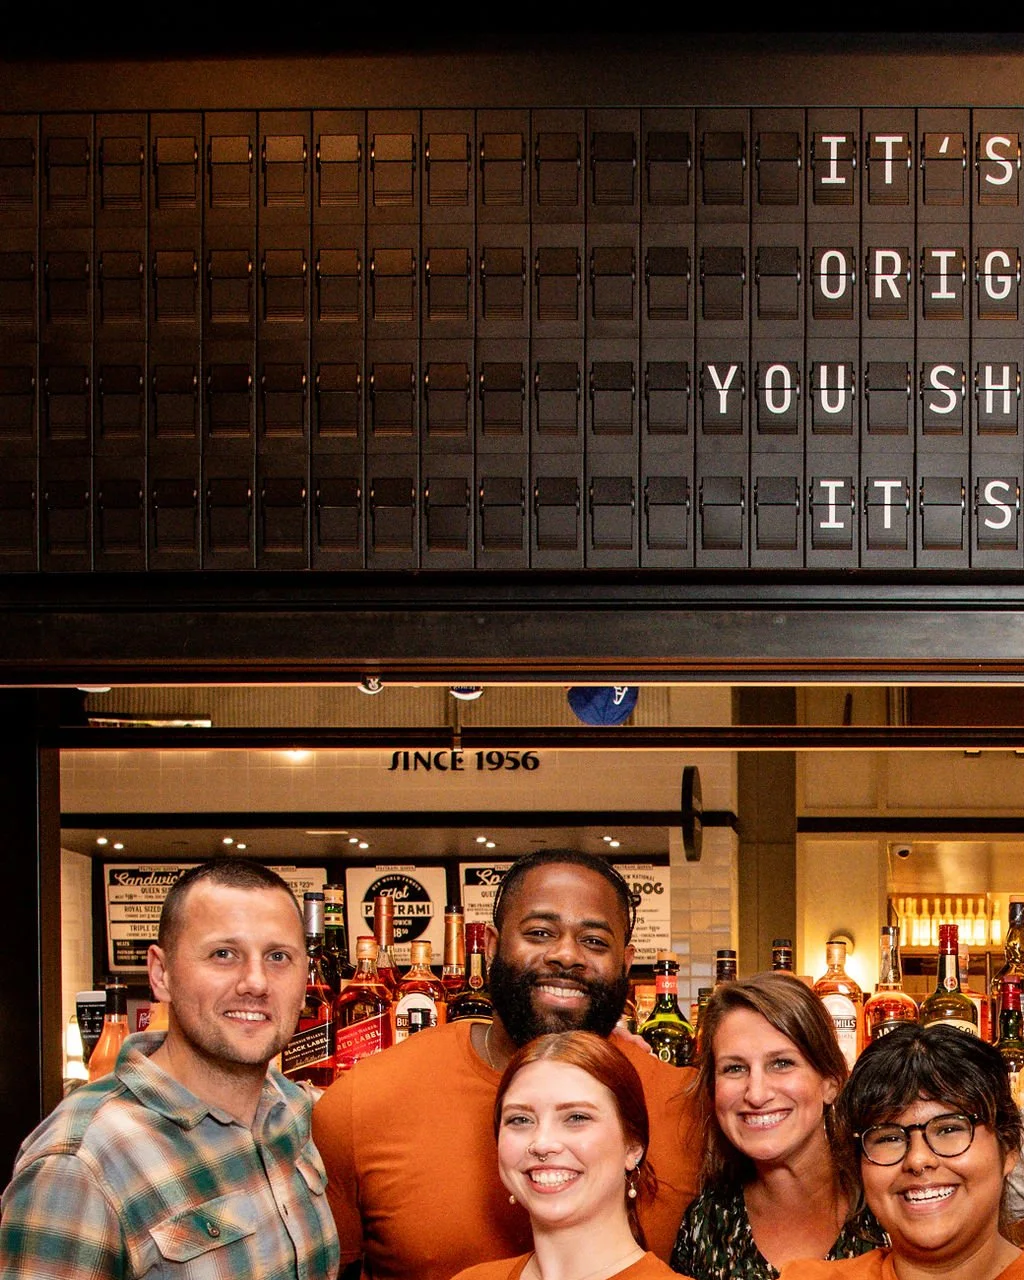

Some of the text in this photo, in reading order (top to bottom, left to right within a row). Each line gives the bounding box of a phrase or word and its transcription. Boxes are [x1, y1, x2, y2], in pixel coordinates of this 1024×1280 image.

[821, 136, 1013, 185] IT'S
[707, 364, 846, 414] YOU
[819, 480, 902, 529] IT
[388, 751, 541, 771] SINCE 1956
[114, 870, 186, 886] Sandwic
[379, 885, 409, 899] Hot
[365, 904, 431, 915] PRAMI
[283, 1037, 331, 1056] BLACK LABEL
[336, 1030, 382, 1051] RED LABEL
